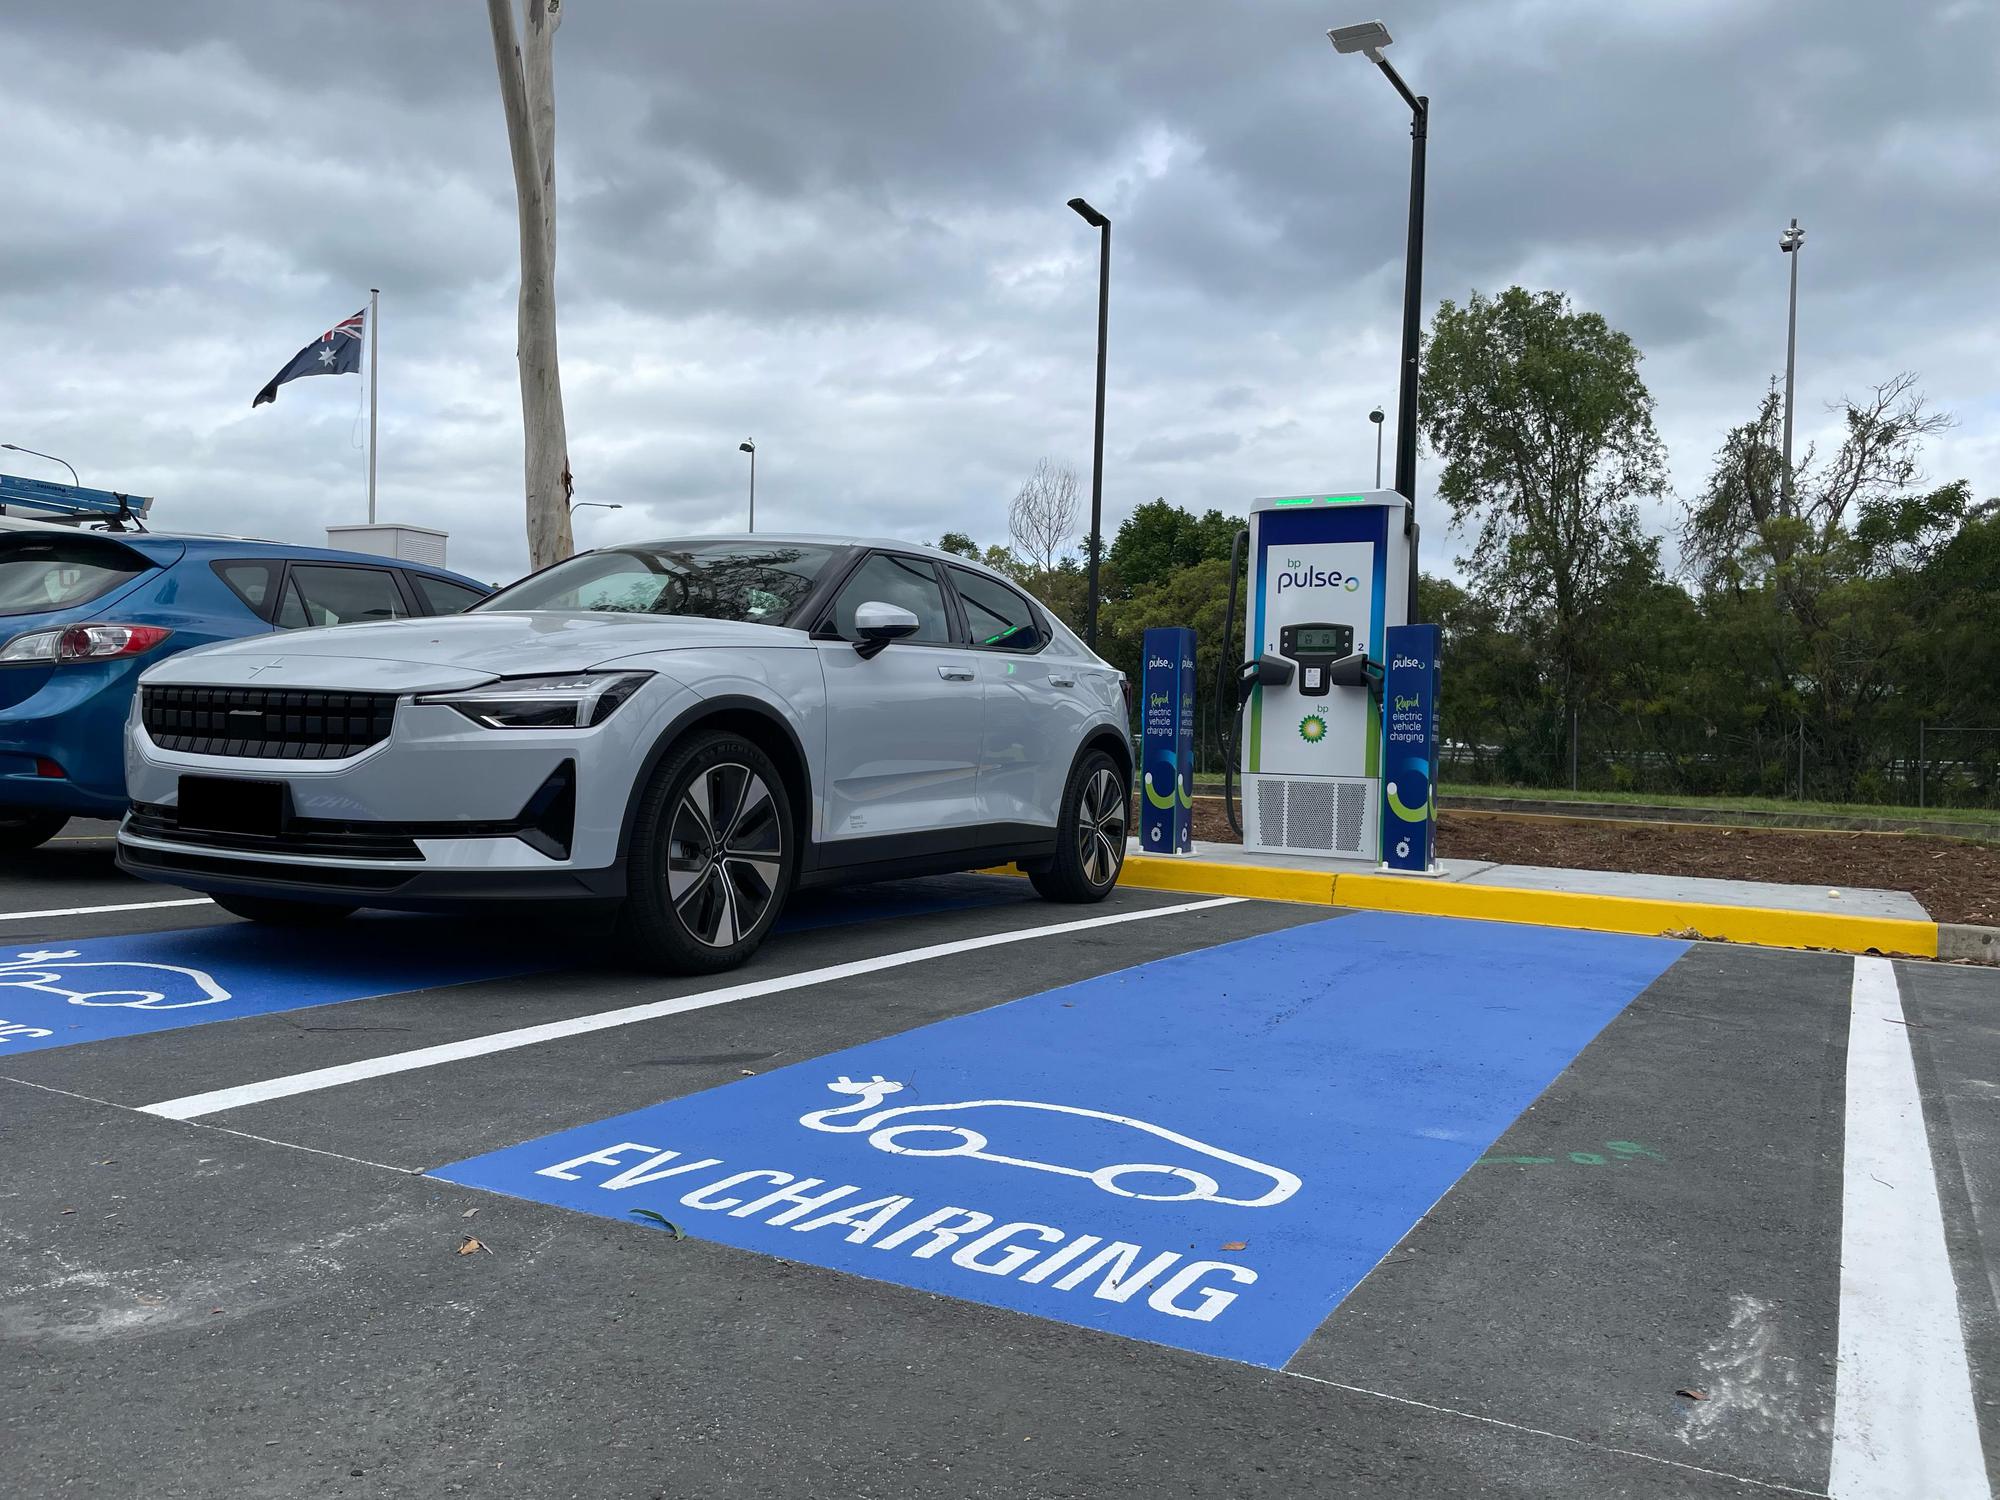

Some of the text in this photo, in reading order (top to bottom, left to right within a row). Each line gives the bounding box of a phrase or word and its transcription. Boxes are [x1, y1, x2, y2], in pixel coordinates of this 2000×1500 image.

[1287, 558, 1301, 569] bp
[1277, 565, 1343, 594] pulse
[1268, 643, 1274, 652] 1
[1357, 643, 1365, 652] 2
[1148, 657, 1169, 670] pulse
[1392, 656, 1419, 671] pulse
[1394, 692, 1420, 712] Rapid
[1148, 708, 1172, 717] electric
[1316, 704, 1329, 715] bp
[1148, 717, 1171, 726] vehicle
[1392, 711, 1423, 721] electric
[1146, 726, 1173, 737] charging
[1392, 721, 1422, 731] vehicle
[1389, 732, 1424, 743] charging
[534, 1142, 1259, 1322] EV CHARGING
